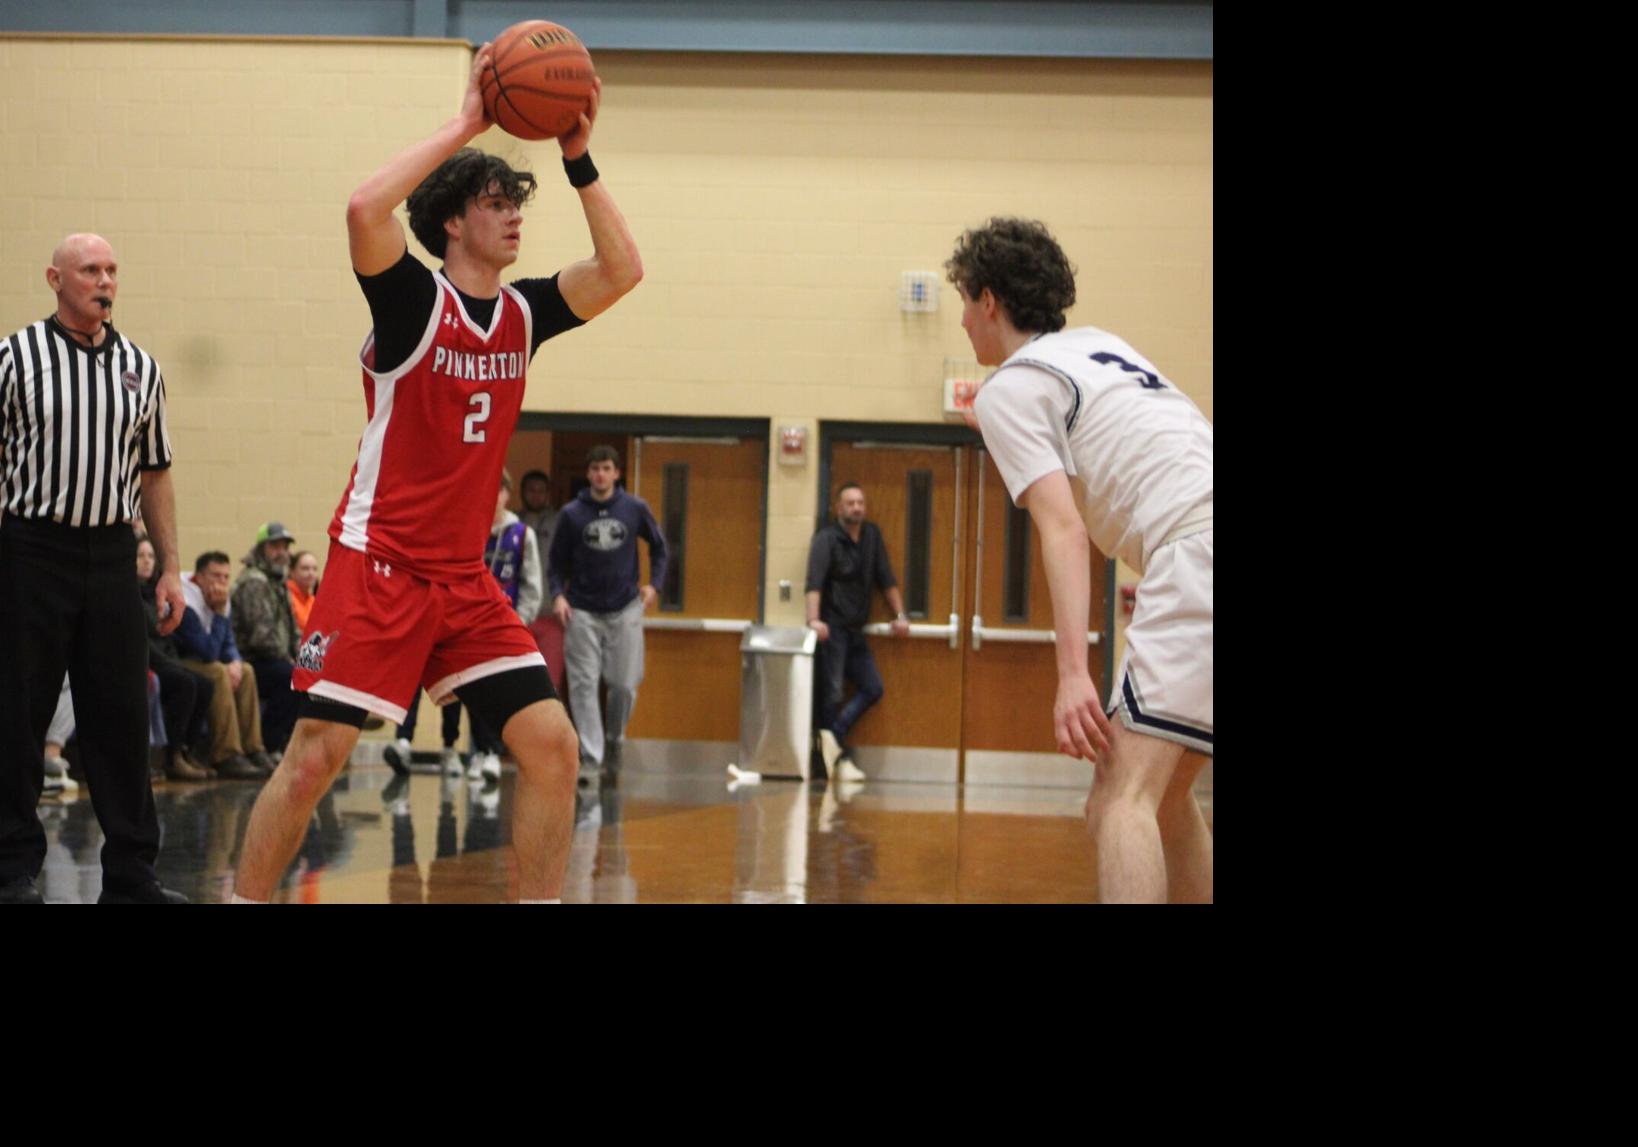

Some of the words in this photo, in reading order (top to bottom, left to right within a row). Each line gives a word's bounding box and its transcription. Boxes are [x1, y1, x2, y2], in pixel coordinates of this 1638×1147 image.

[432, 346, 525, 381] PINKERTON
[1089, 351, 1168, 389] 3
[463, 391, 492, 443] 2
